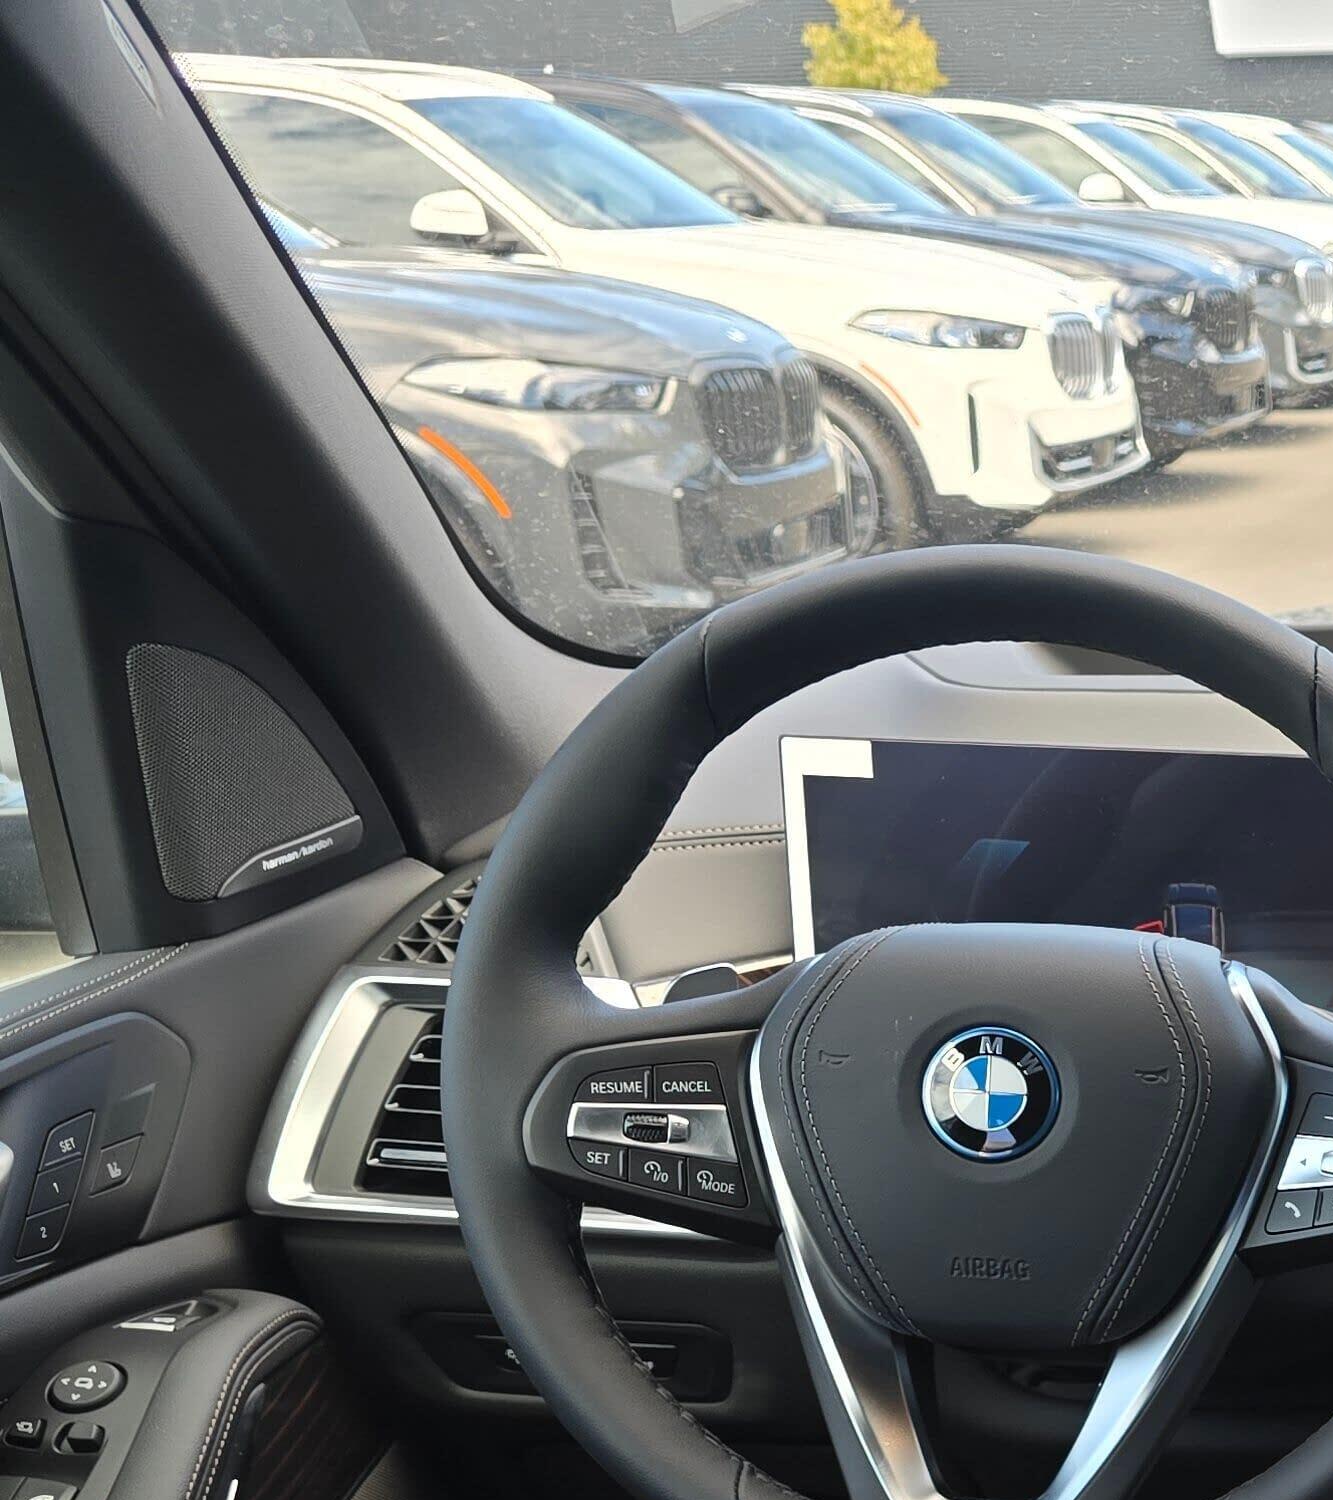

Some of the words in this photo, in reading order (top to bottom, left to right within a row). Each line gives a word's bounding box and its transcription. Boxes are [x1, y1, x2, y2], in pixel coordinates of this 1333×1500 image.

[941, 1035, 1043, 1076] BMW
[590, 1081, 644, 1094] RESUME
[662, 1080, 712, 1093] CANCEL
[58, 1137, 76, 1153] SET
[586, 1151, 611, 1165] SET
[701, 1180, 736, 1194] MODE
[40, 1226, 48, 1239] 2
[950, 1256, 1030, 1280] AIRBAG
